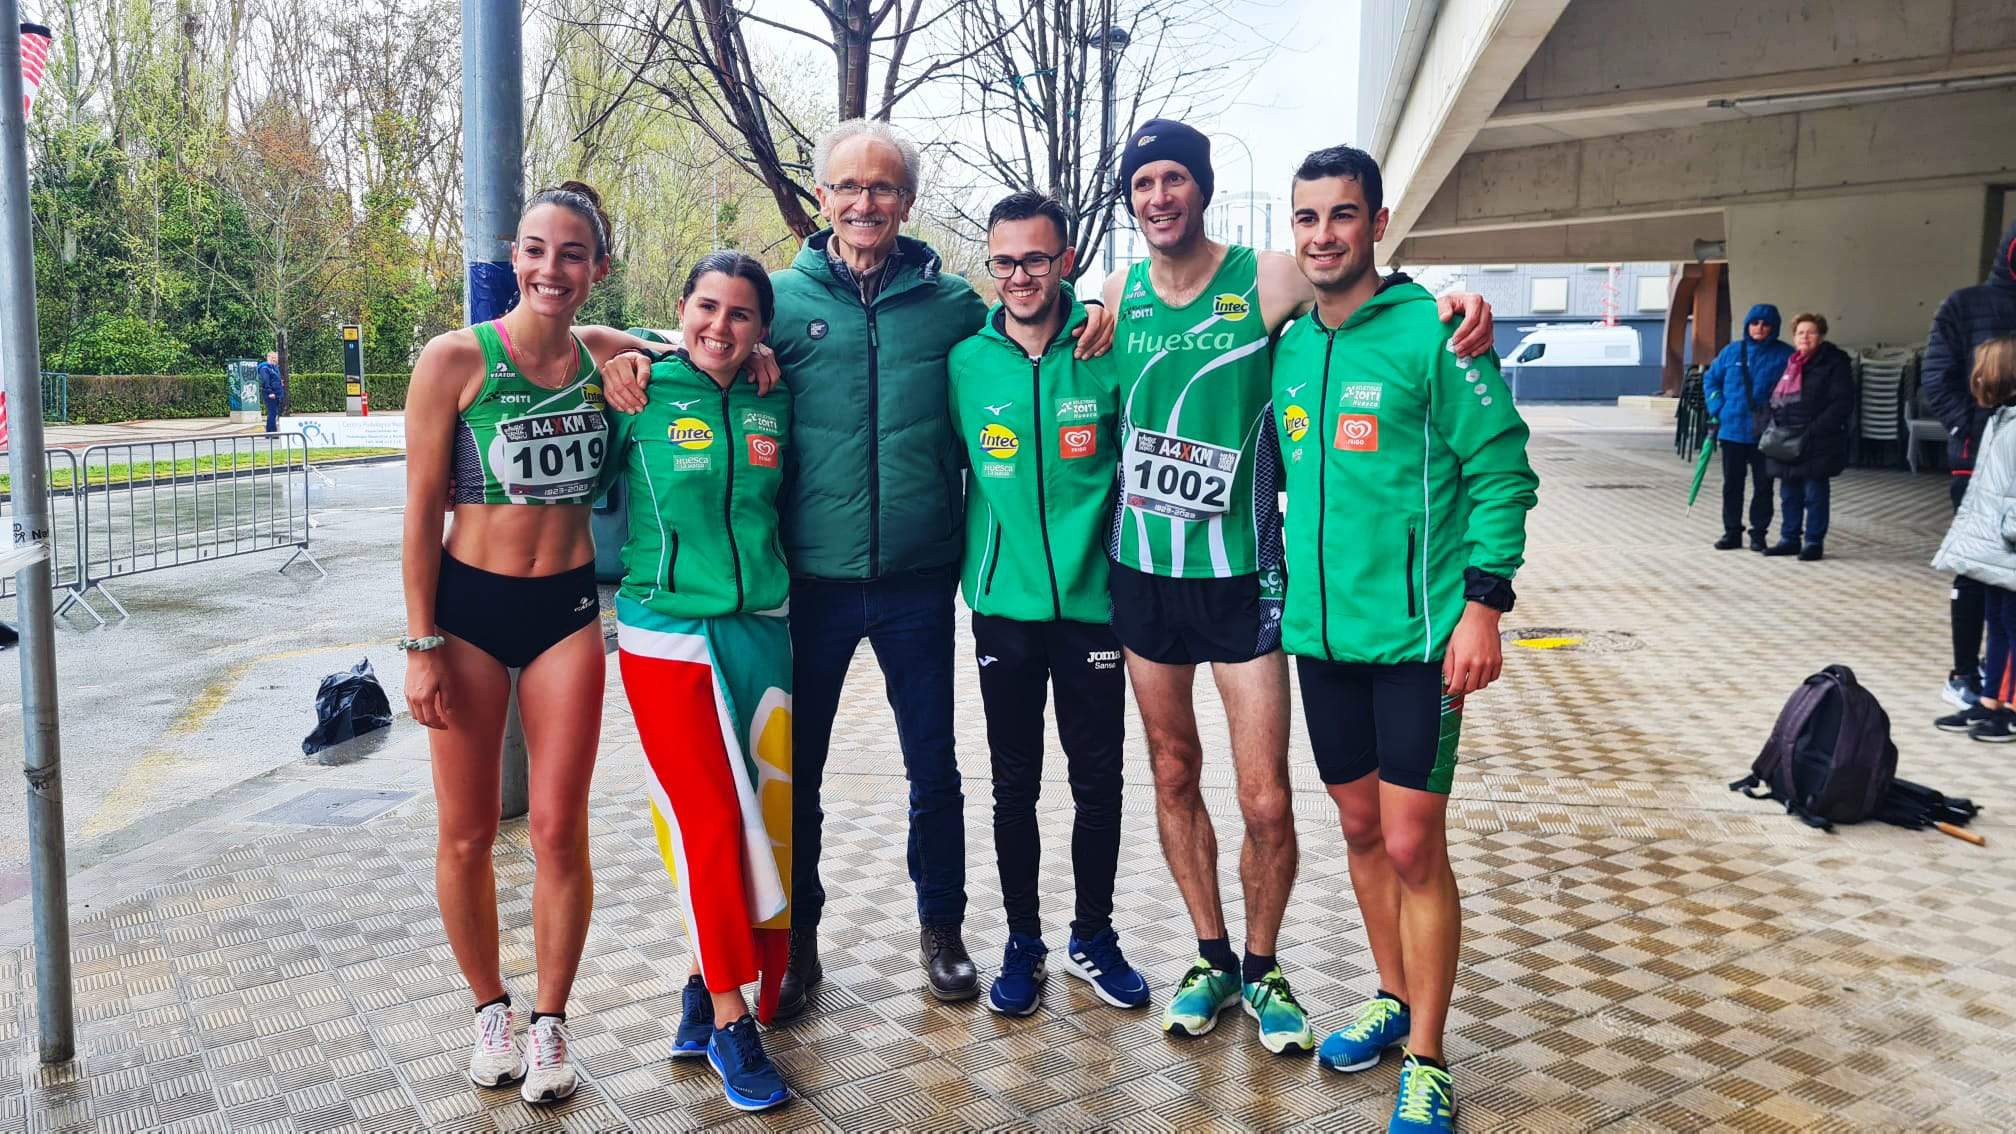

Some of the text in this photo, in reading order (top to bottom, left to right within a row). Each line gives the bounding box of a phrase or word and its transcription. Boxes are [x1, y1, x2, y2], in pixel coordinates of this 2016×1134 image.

[1127, 331, 1235, 354] Huesca
[500, 394, 531, 404] ZOITI
[1073, 403, 1097, 413] ZOITI
[531, 414, 587, 438] A4XKM
[512, 437, 604, 480] 1019
[1159, 439, 1214, 467] A4XKM
[1134, 459, 1227, 507] 1002
